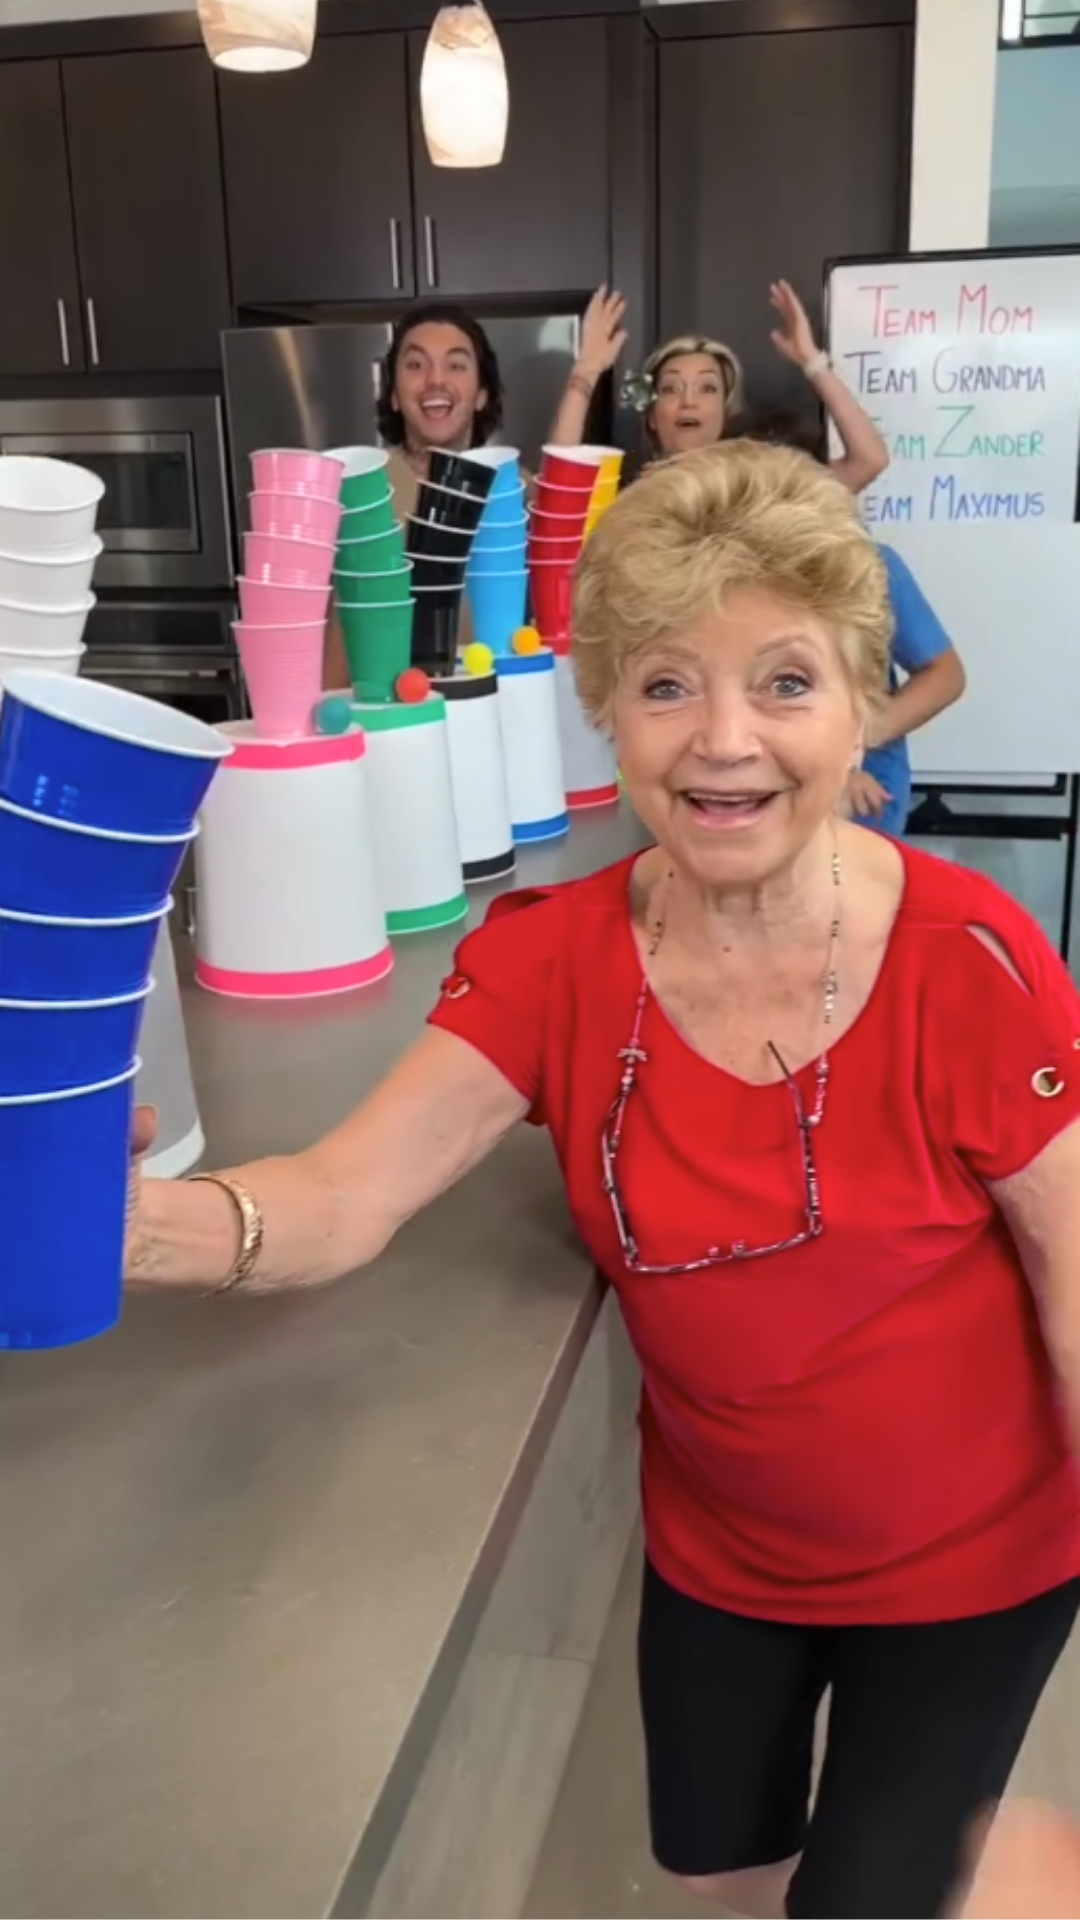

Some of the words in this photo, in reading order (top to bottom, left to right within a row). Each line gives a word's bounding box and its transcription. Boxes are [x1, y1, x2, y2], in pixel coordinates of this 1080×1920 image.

[857, 284, 936, 338] TEAM
[956, 283, 1034, 336] MOM
[843, 350, 917, 394] TEAM
[932, 346, 1046, 394] GRANDMA
[871, 416, 925, 460] AM
[933, 404, 1045, 458] ZANDER
[864, 495, 912, 522] EAM
[929, 474, 1046, 520] MAXIMUS
